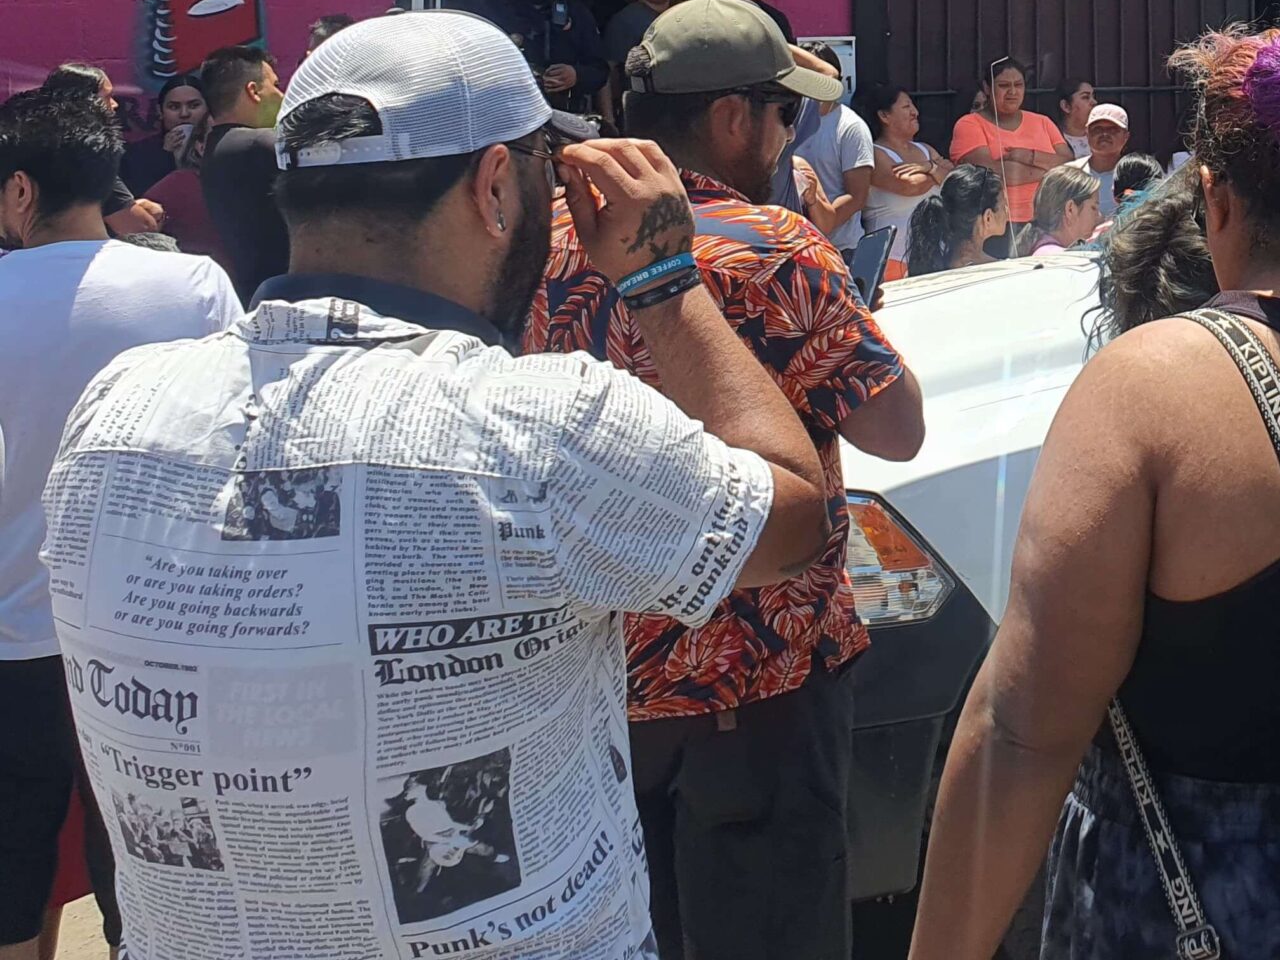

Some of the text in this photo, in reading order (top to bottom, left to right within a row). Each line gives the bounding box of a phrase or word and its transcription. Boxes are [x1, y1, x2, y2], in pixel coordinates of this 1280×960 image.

[652, 259, 681, 275] COFFEE
[498, 521, 546, 541] Punk
[126, 573, 303, 601] or are you taking orders?
[178, 565, 204, 577] you
[208, 566, 252, 583] taking
[256, 568, 288, 581] over
[122, 591, 303, 618] Are you going backwards
[114, 610, 310, 639] or are you going forwards?
[374, 625, 455, 651] WHO
[457, 615, 526, 645] ARE
[374, 651, 504, 687] London
[87, 658, 199, 735] Today
[100, 742, 203, 791] “Trigger
[213, 766, 313, 796] point”
[1110, 707, 1151, 806] KIPLING
[408, 920, 513, 958] Punk’s
[514, 895, 557, 932] not
[560, 830, 615, 904] dead!
